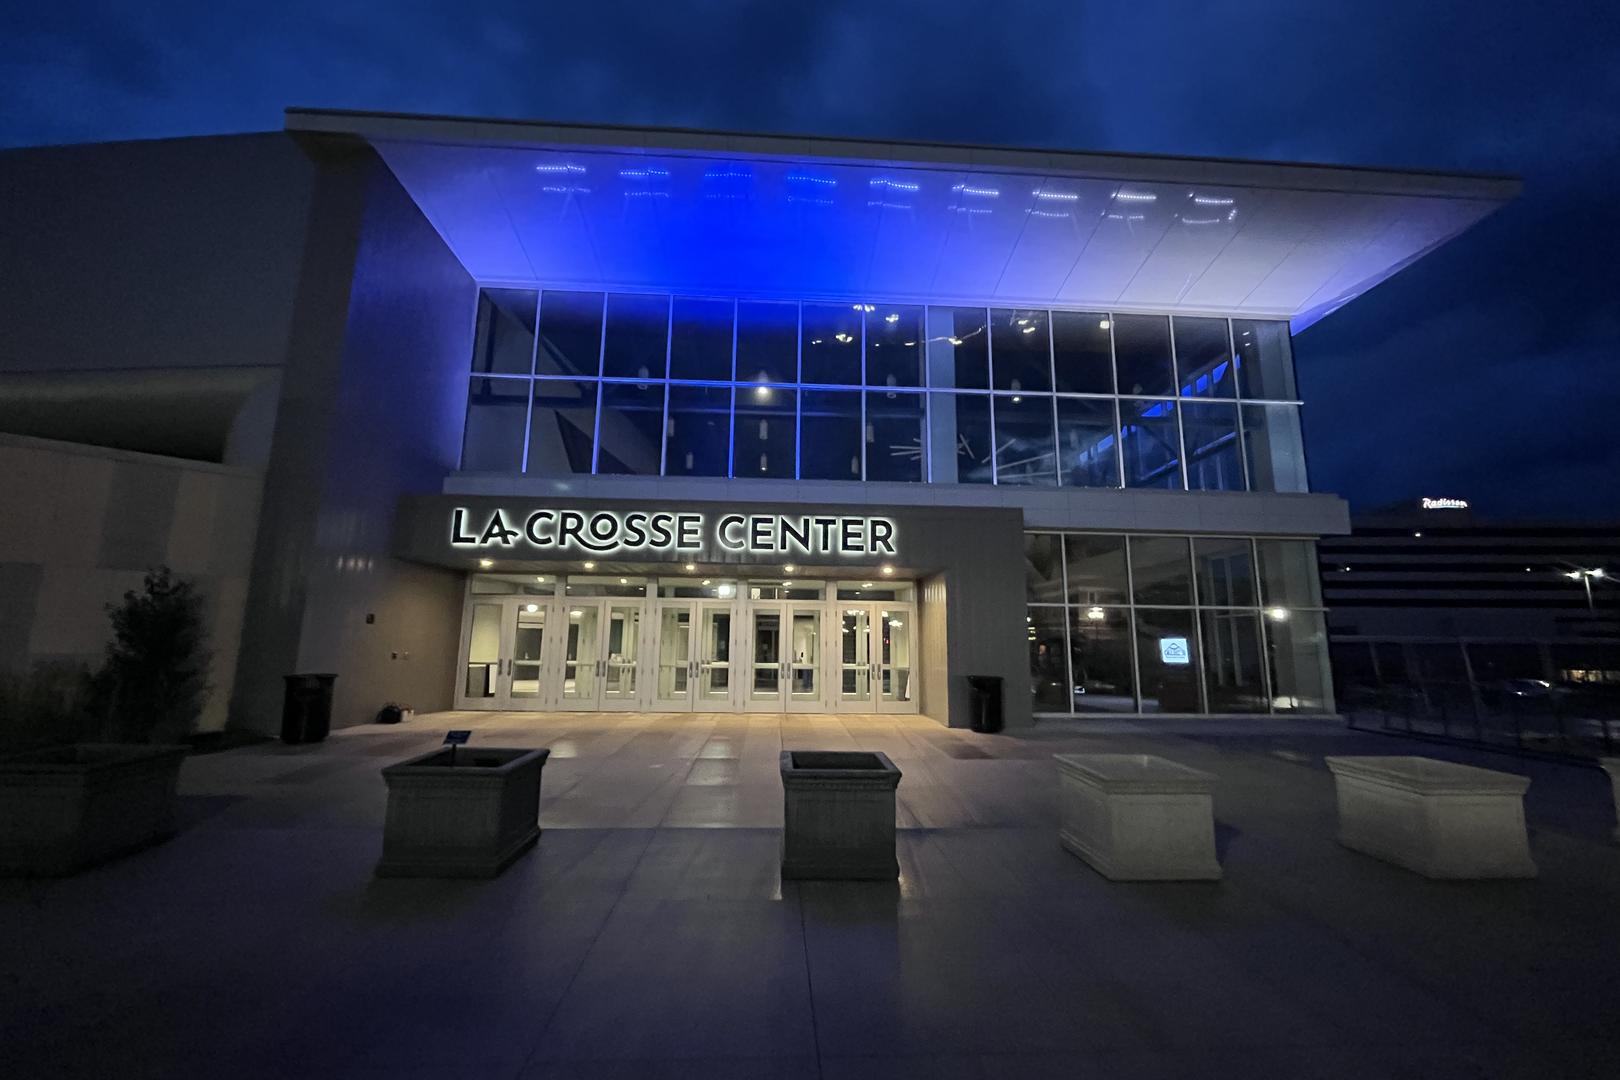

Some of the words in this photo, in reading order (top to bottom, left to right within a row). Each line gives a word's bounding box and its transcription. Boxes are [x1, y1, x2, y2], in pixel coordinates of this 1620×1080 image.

[1422, 497, 1468, 509] Radisson
[452, 508, 518, 546] LA
[525, 511, 702, 551] CROSSE
[718, 515, 895, 552] CENTER
